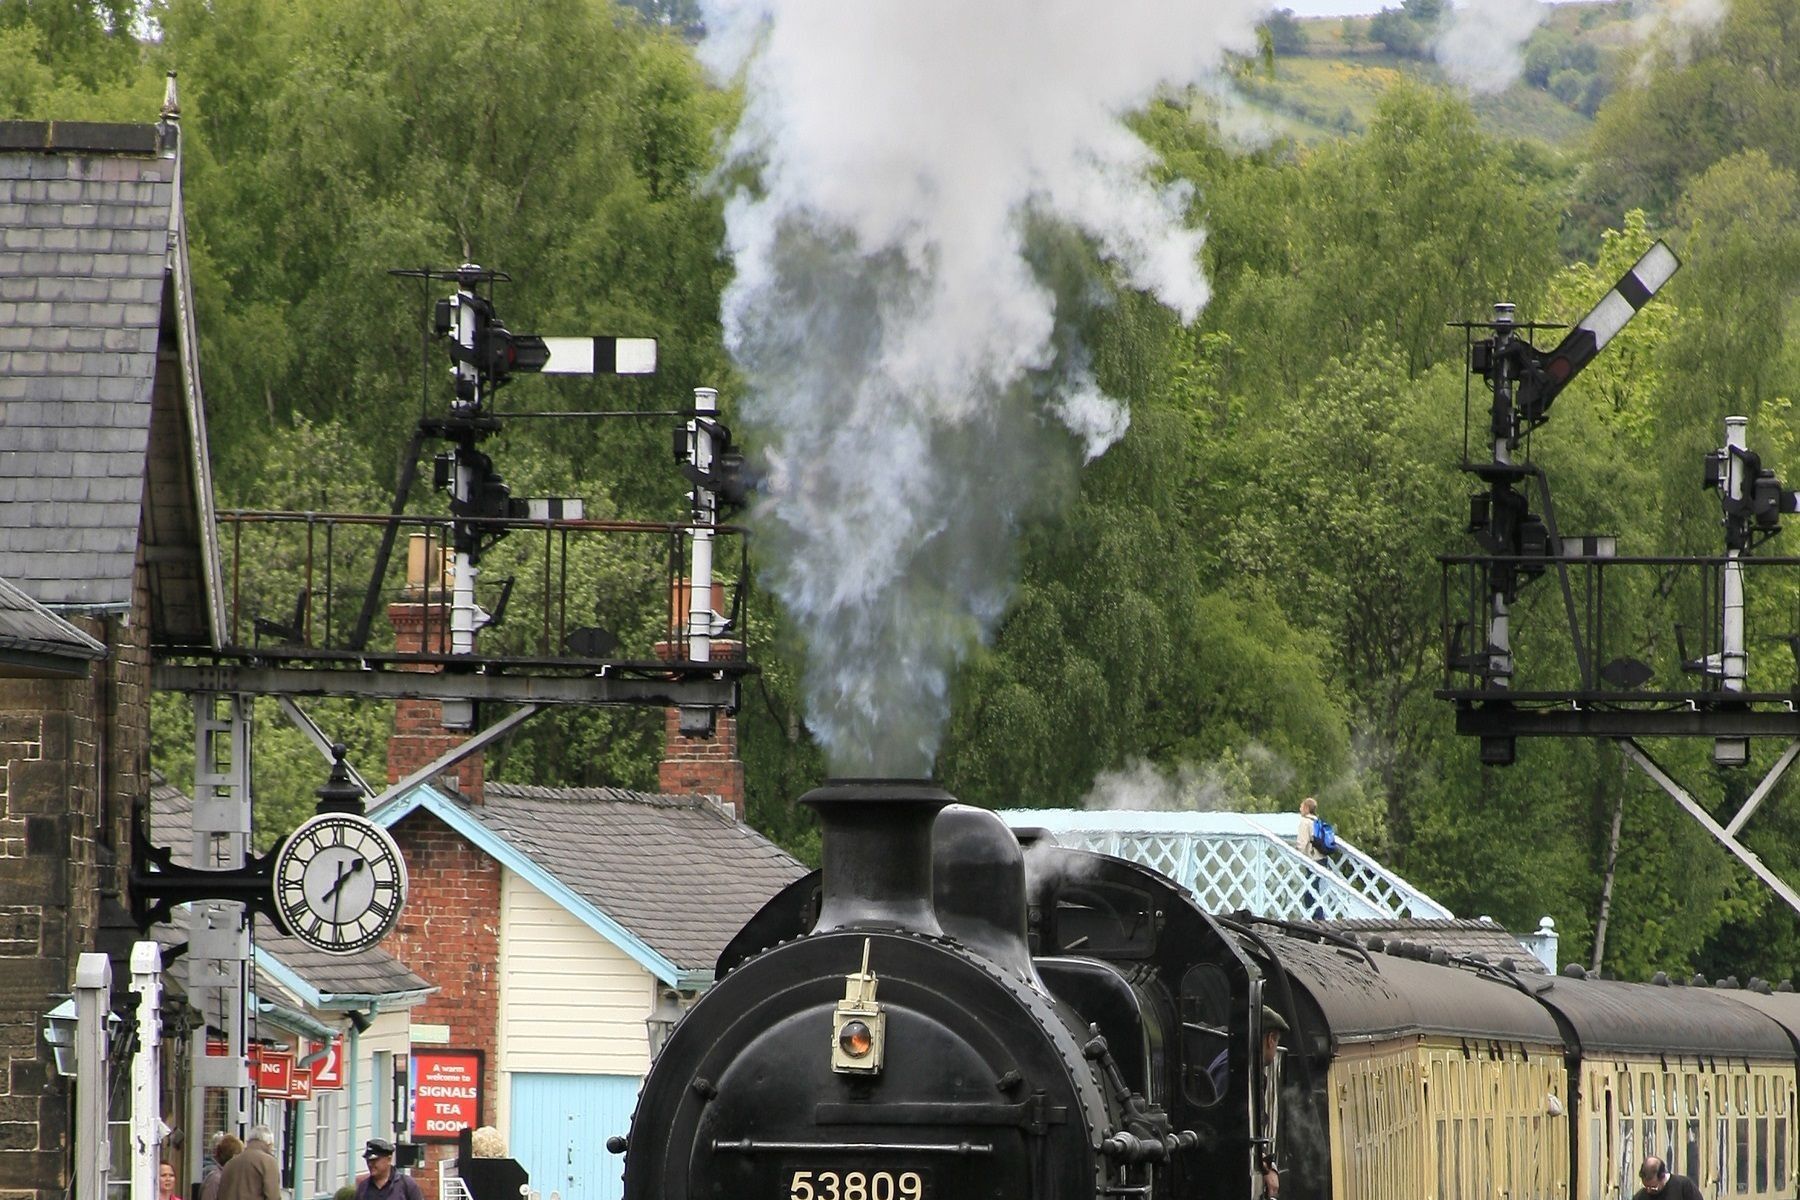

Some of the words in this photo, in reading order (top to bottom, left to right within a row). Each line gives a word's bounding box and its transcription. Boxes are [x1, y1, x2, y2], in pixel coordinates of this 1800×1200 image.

[316, 1050, 337, 1080] 2
[433, 1064, 440, 1072] A
[426, 1073, 460, 1081] welcome
[461, 1074, 471, 1082] to
[419, 1086, 477, 1098] SIGNALS
[434, 1103, 461, 1115] TEA
[426, 1120, 468, 1132] ROOM
